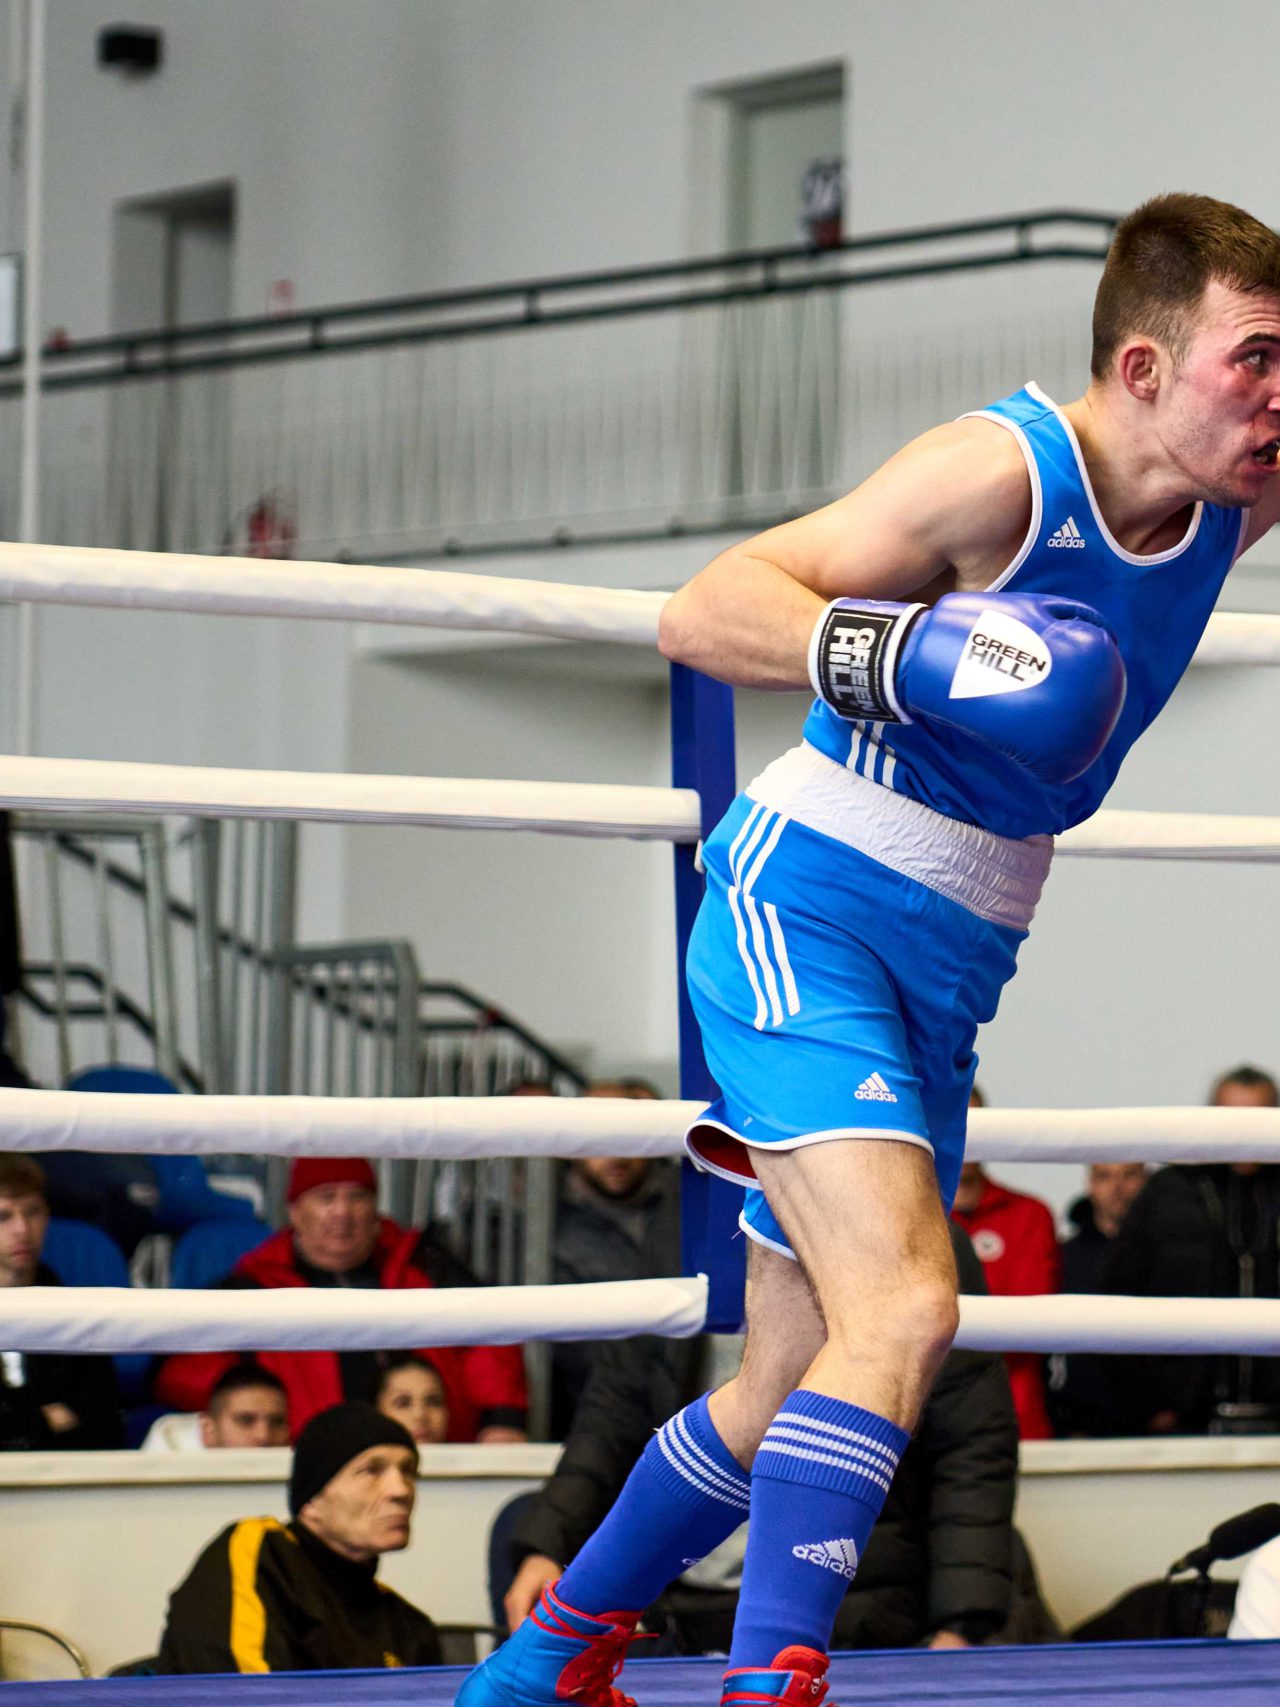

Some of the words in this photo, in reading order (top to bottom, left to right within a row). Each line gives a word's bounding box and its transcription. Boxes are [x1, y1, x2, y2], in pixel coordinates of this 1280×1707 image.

[1047, 536, 1086, 549] adidas
[829, 627, 859, 701] HILL
[850, 627, 880, 713] GREEN
[968, 645, 1025, 682] HILL
[972, 633, 1046, 672] GREEN
[854, 1089, 898, 1103] adidas
[792, 1545, 856, 1580] adida
